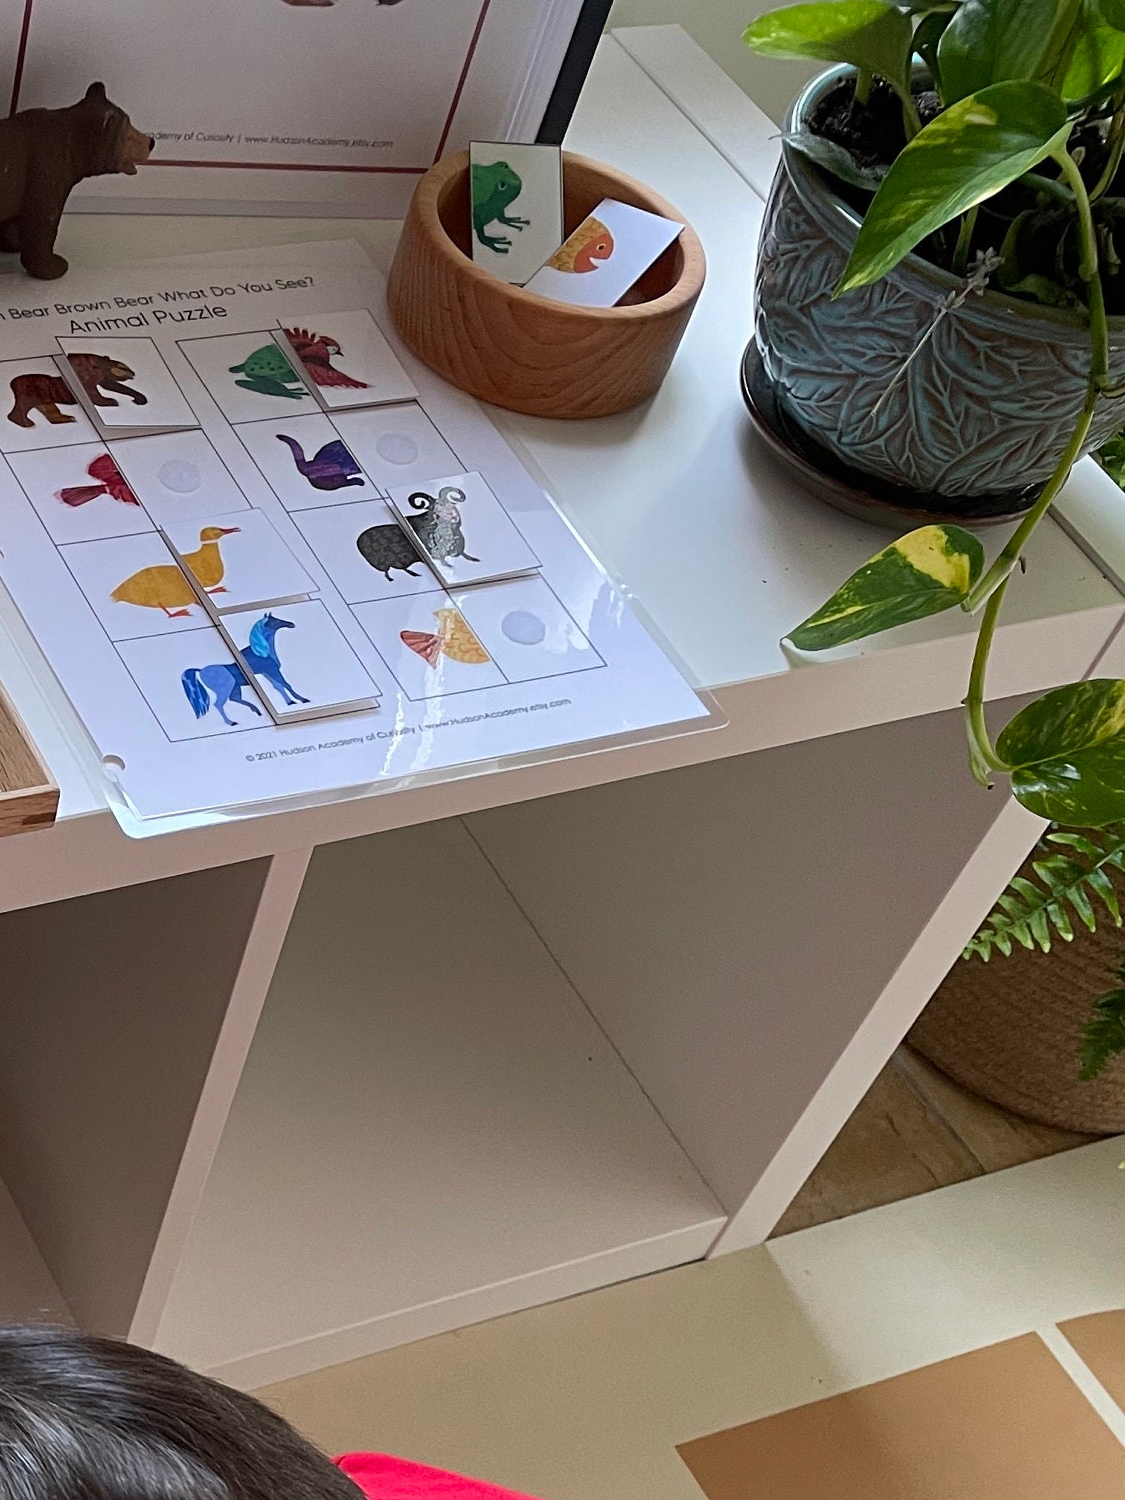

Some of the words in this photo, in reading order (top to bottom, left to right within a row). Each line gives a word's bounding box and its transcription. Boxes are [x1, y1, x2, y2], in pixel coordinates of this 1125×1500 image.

[8, 307, 49, 320] Bear
[54, 300, 111, 315] Brown
[114, 296, 154, 308] Bear
[158, 289, 207, 303] What
[210, 286, 236, 297] Do
[238, 282, 273, 293] You
[275, 276, 314, 290] See?
[70, 313, 149, 334] Animal
[152, 305, 228, 324] Puzzle
[256, 752, 278, 761] 2021
[280, 745, 316, 756] Hudson
[318, 737, 364, 750] Academy
[366, 733, 376, 742] of
